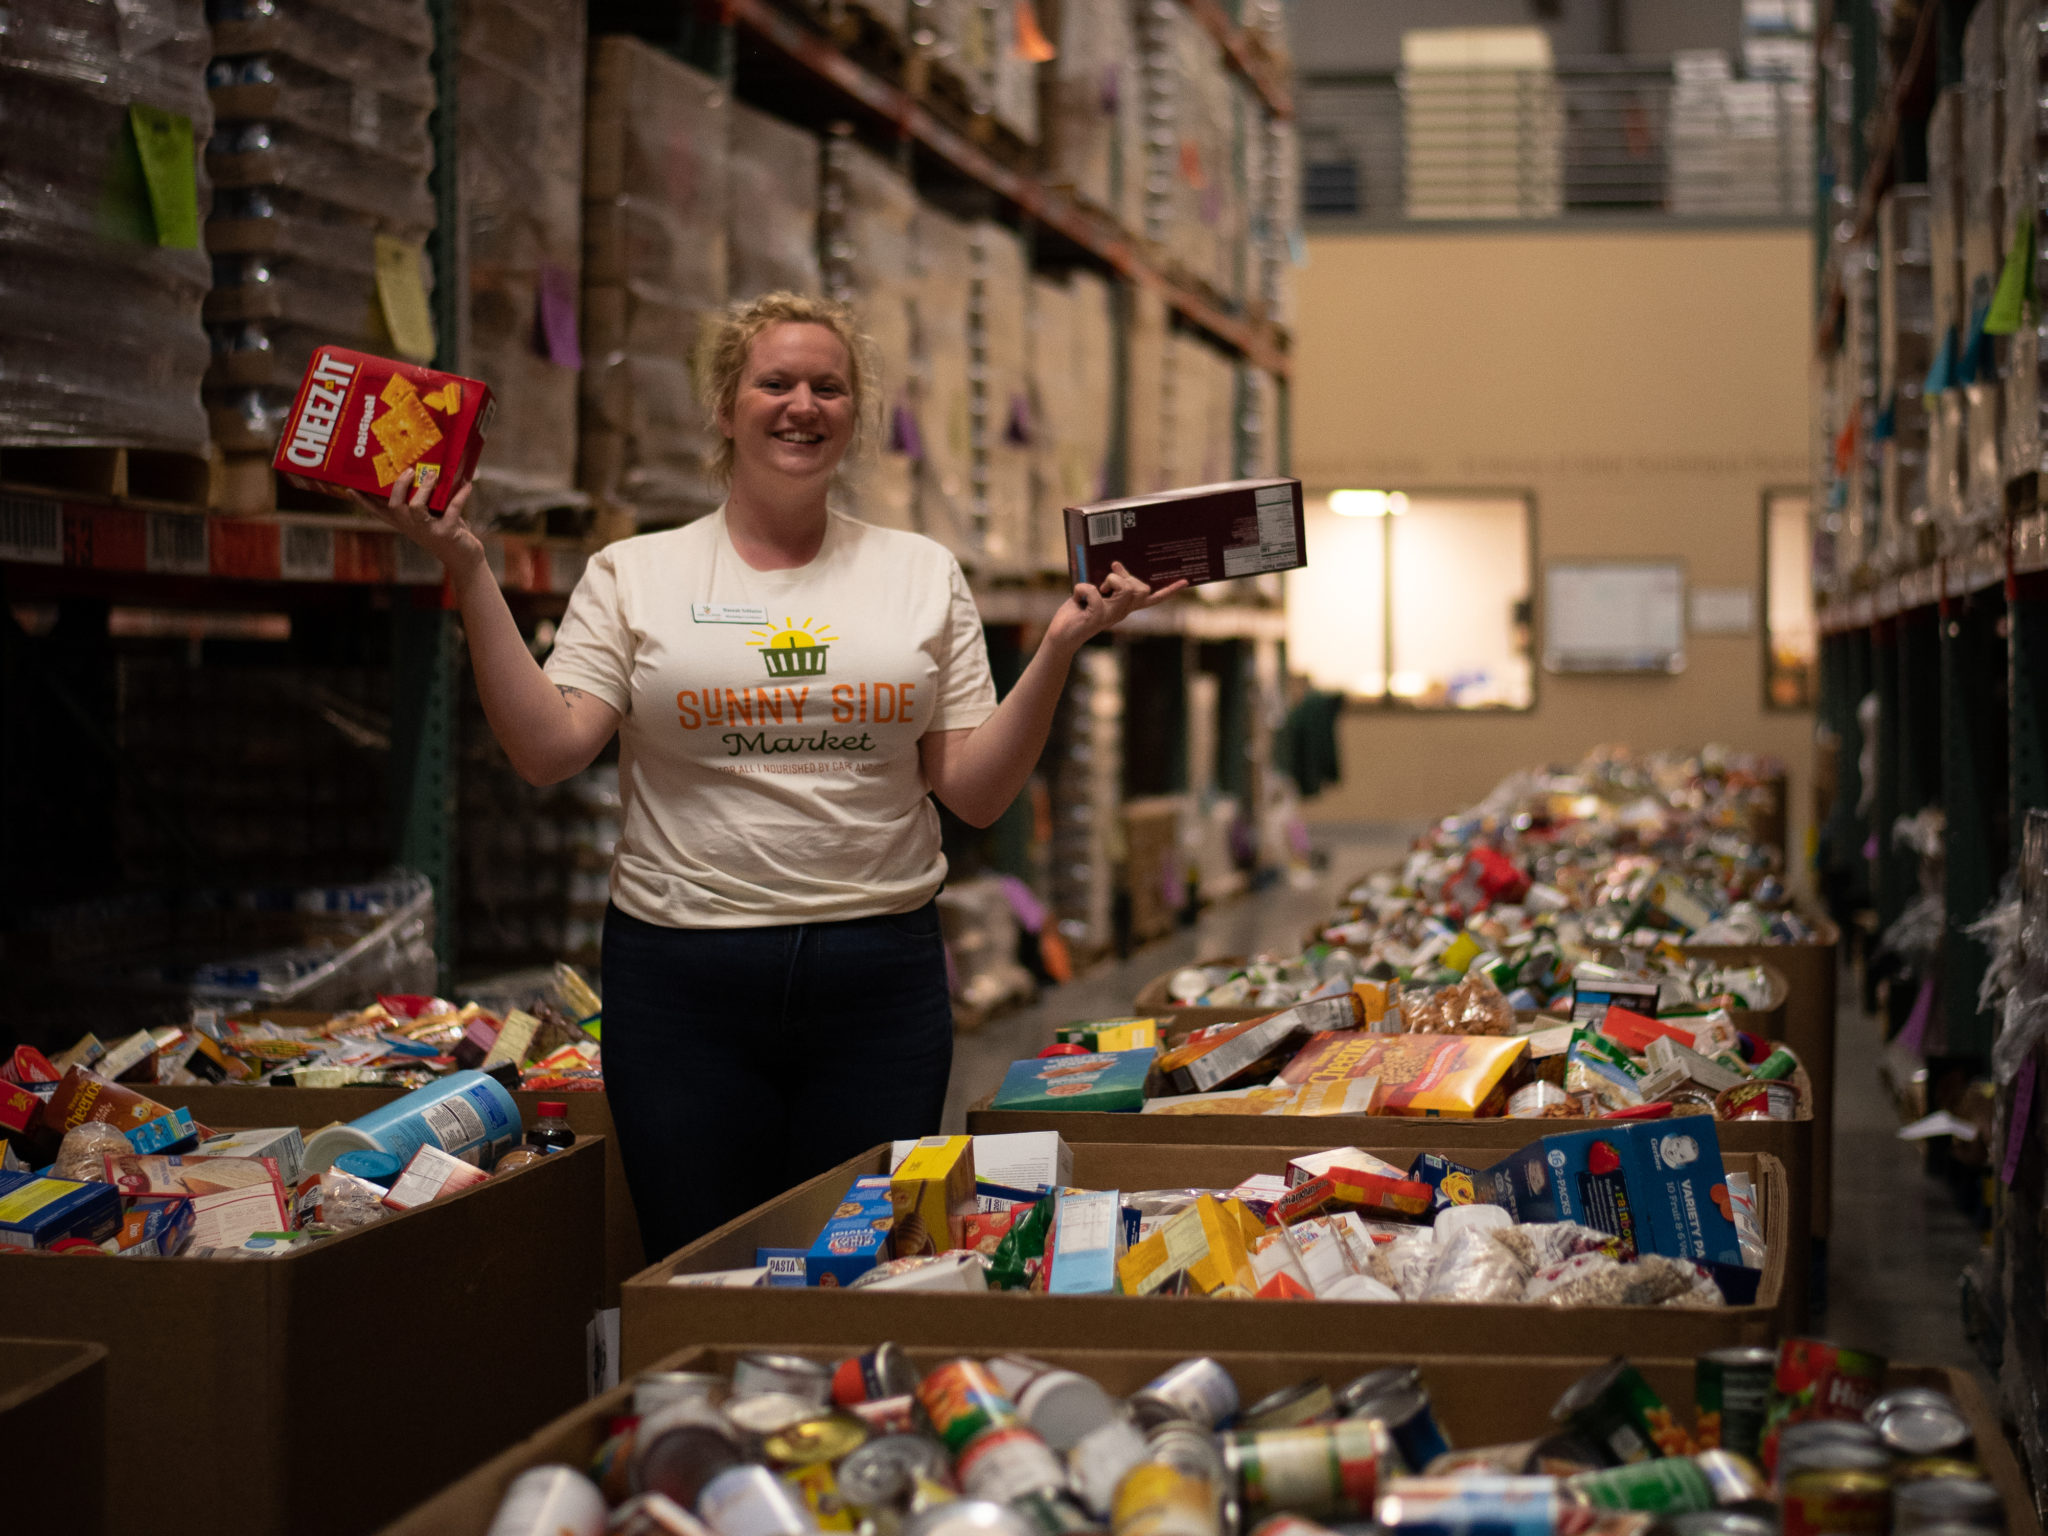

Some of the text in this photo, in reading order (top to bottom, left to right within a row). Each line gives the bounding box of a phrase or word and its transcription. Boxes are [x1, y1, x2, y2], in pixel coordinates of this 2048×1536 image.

[676, 682, 916, 730] SUNNY SIDE
[722, 730, 876, 757] Market
[738, 763, 754, 774] ALL
[763, 762, 817, 775] NOURISHED
[818, 762, 830, 773] BY
[64, 1080, 104, 1132] Cheerios
[1553, 1168, 1572, 1216] 2-PACKS
[1680, 1178, 1706, 1259] VARIETY PA
[769, 1258, 795, 1273] PASTA
